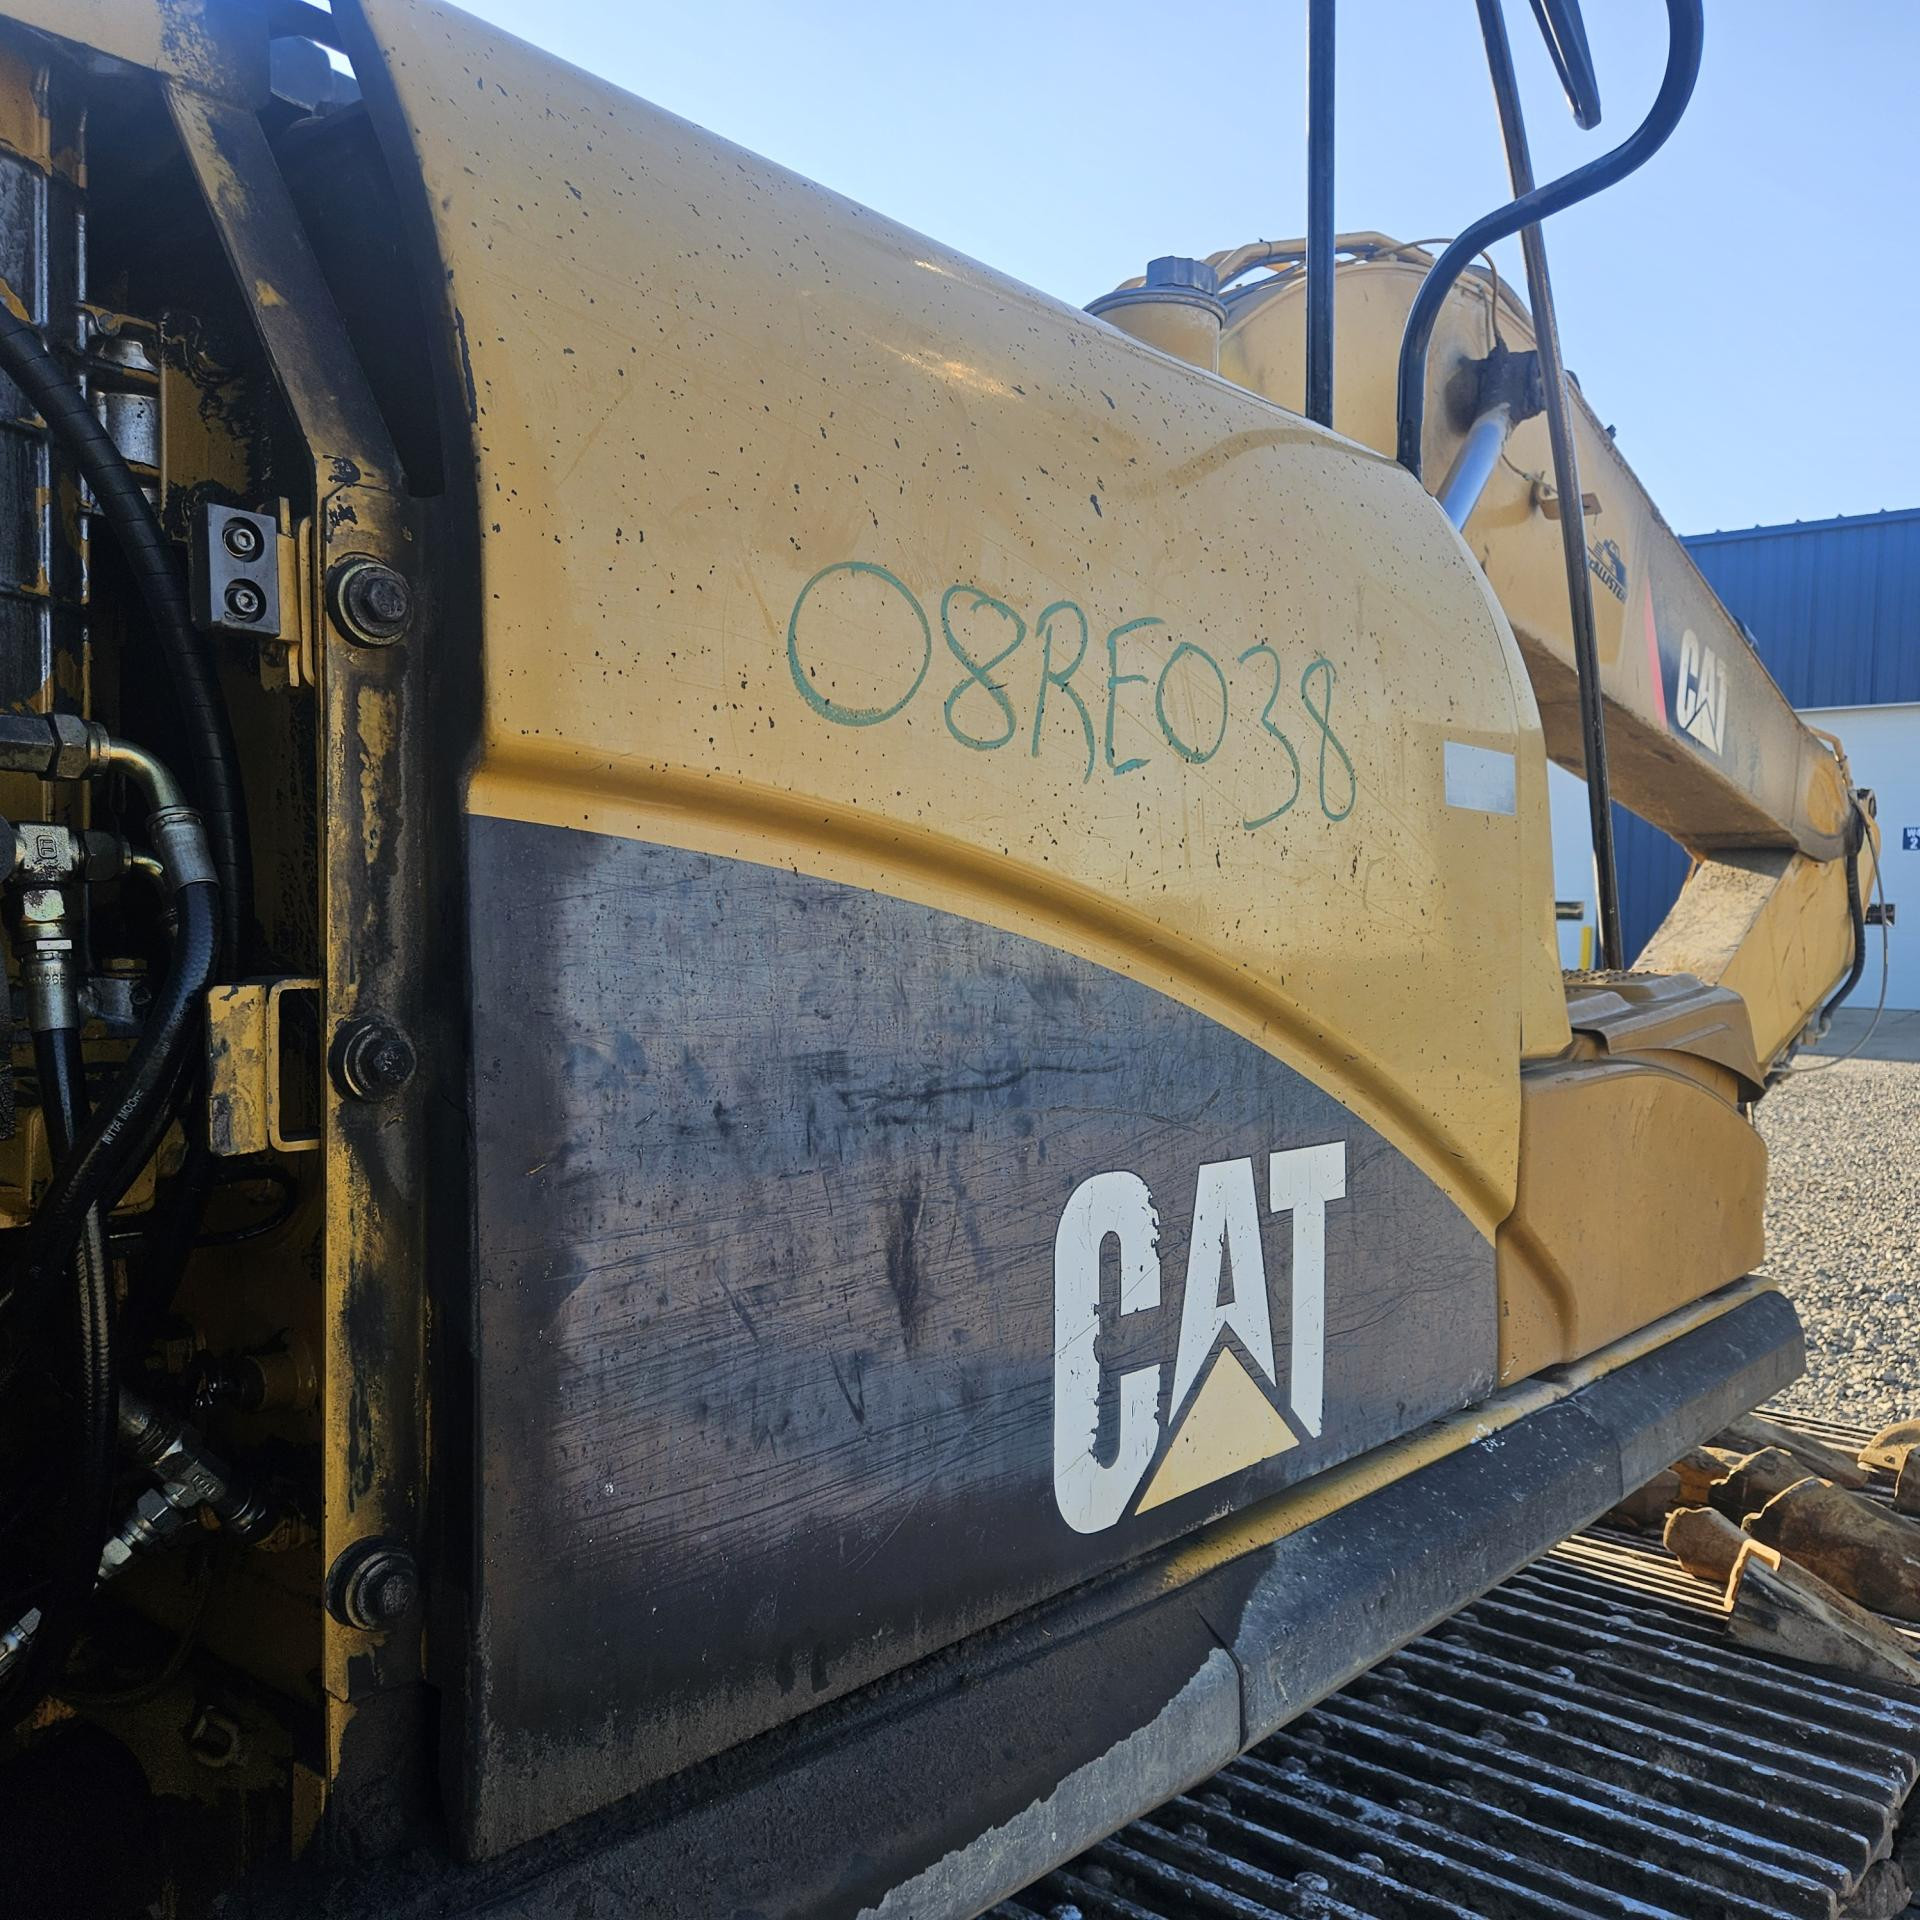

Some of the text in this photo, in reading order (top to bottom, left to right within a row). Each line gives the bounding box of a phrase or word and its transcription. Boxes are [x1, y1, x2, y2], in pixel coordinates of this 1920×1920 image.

[787, 561, 1356, 830] 08RE038
[1676, 628, 1728, 757] CAT
[1054, 1141, 1346, 1534] CAT
